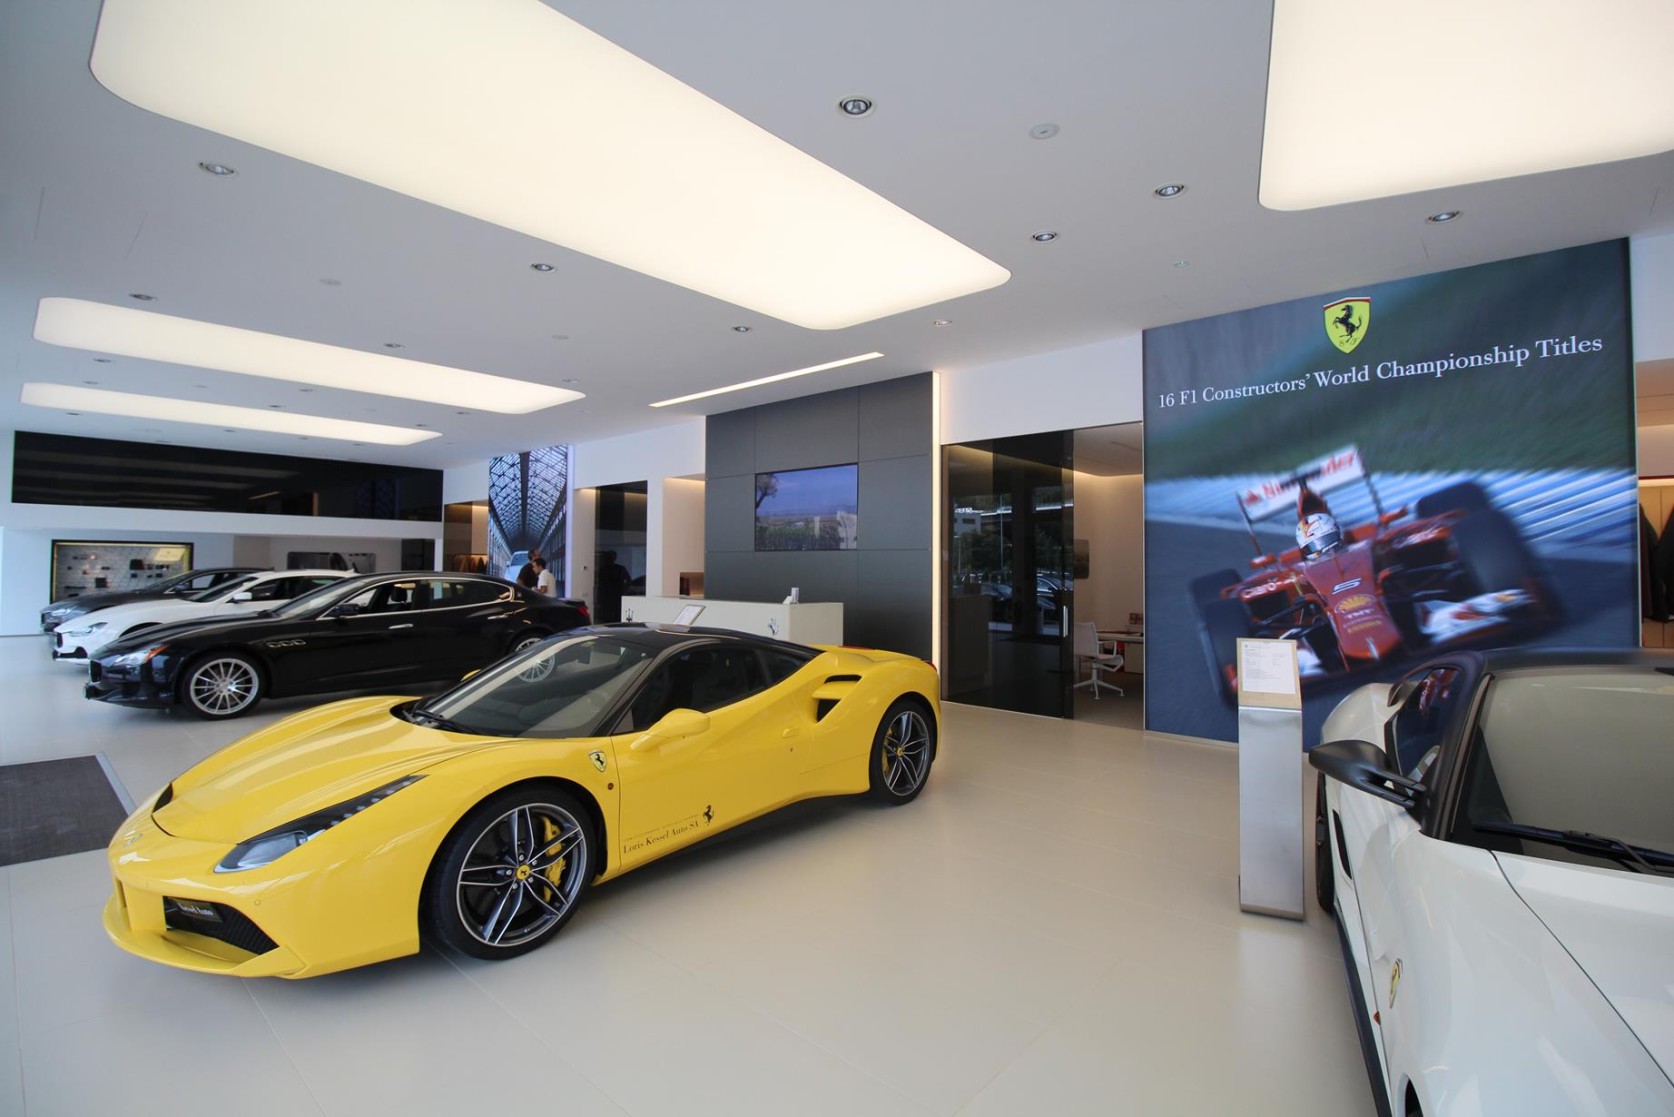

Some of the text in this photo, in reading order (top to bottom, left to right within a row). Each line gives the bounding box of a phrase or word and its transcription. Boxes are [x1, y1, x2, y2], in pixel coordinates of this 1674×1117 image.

[1159, 392, 1175, 408] 16
[1179, 389, 1197, 406] F1
[1313, 365, 1370, 388] World
[1376, 345, 1530, 377] Championship
[1535, 335, 1603, 358] Titles
[646, 830, 669, 846] Kessel
[672, 823, 689, 836] Auto
